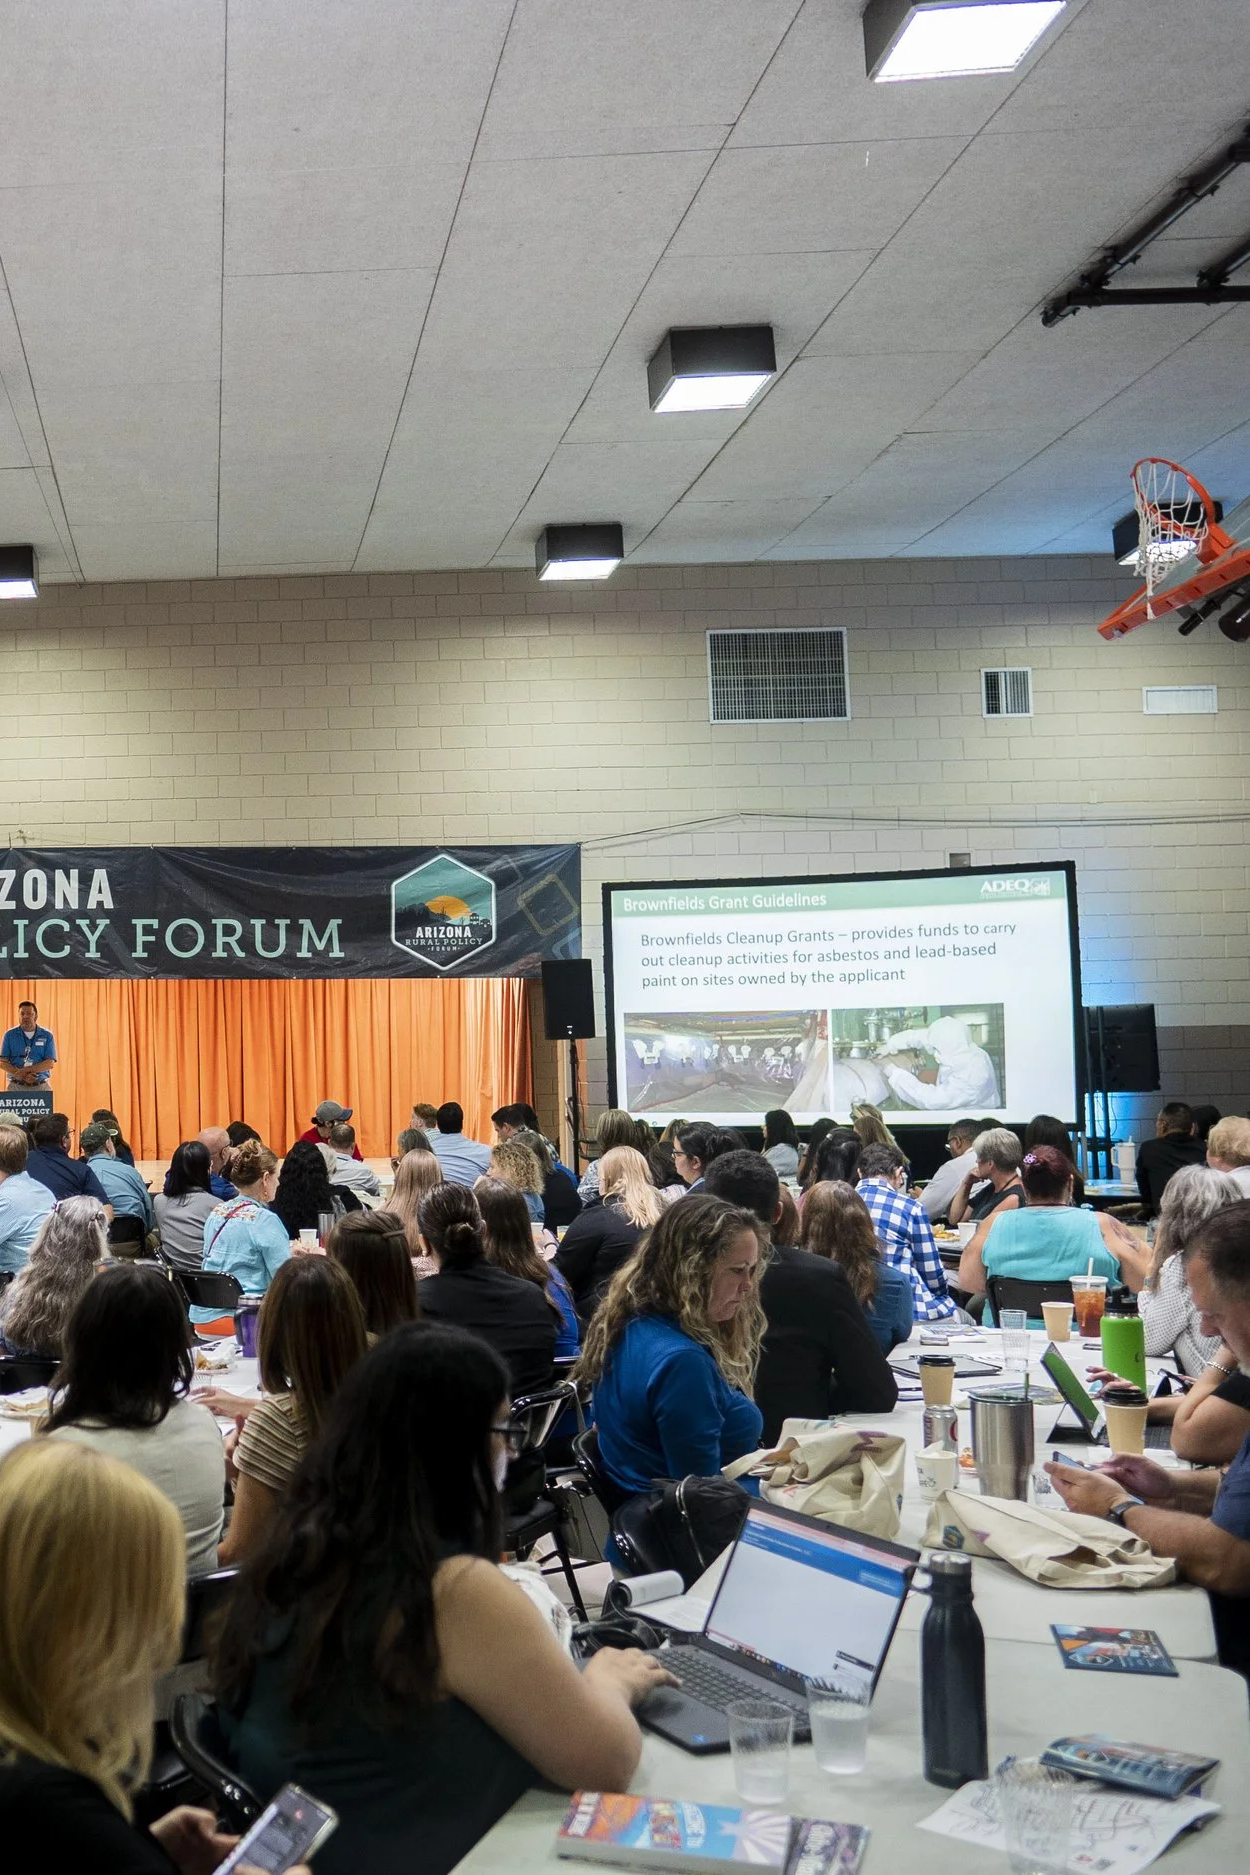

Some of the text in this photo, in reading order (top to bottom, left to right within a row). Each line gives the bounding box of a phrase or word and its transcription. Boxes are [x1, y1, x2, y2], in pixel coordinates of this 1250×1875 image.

[980, 879, 1030, 893] ADEQ
[624, 892, 826, 912] Brownfields Grant Guidelines
[132, 918, 345, 959] FORUM
[415, 926, 472, 939] ARIZONA
[641, 932, 722, 947] Brownfields
[727, 932, 783, 947] Cleanup
[788, 930, 834, 943] Grants
[852, 926, 913, 944] provides
[918, 923, 958, 938] funds
[964, 924, 979, 936] to
[984, 925, 1016, 936] carry
[642, 942, 996, 969] out cleanup activities for asbestos and lead-based
[643, 969, 905, 990] paint on sites owned by the applicant
